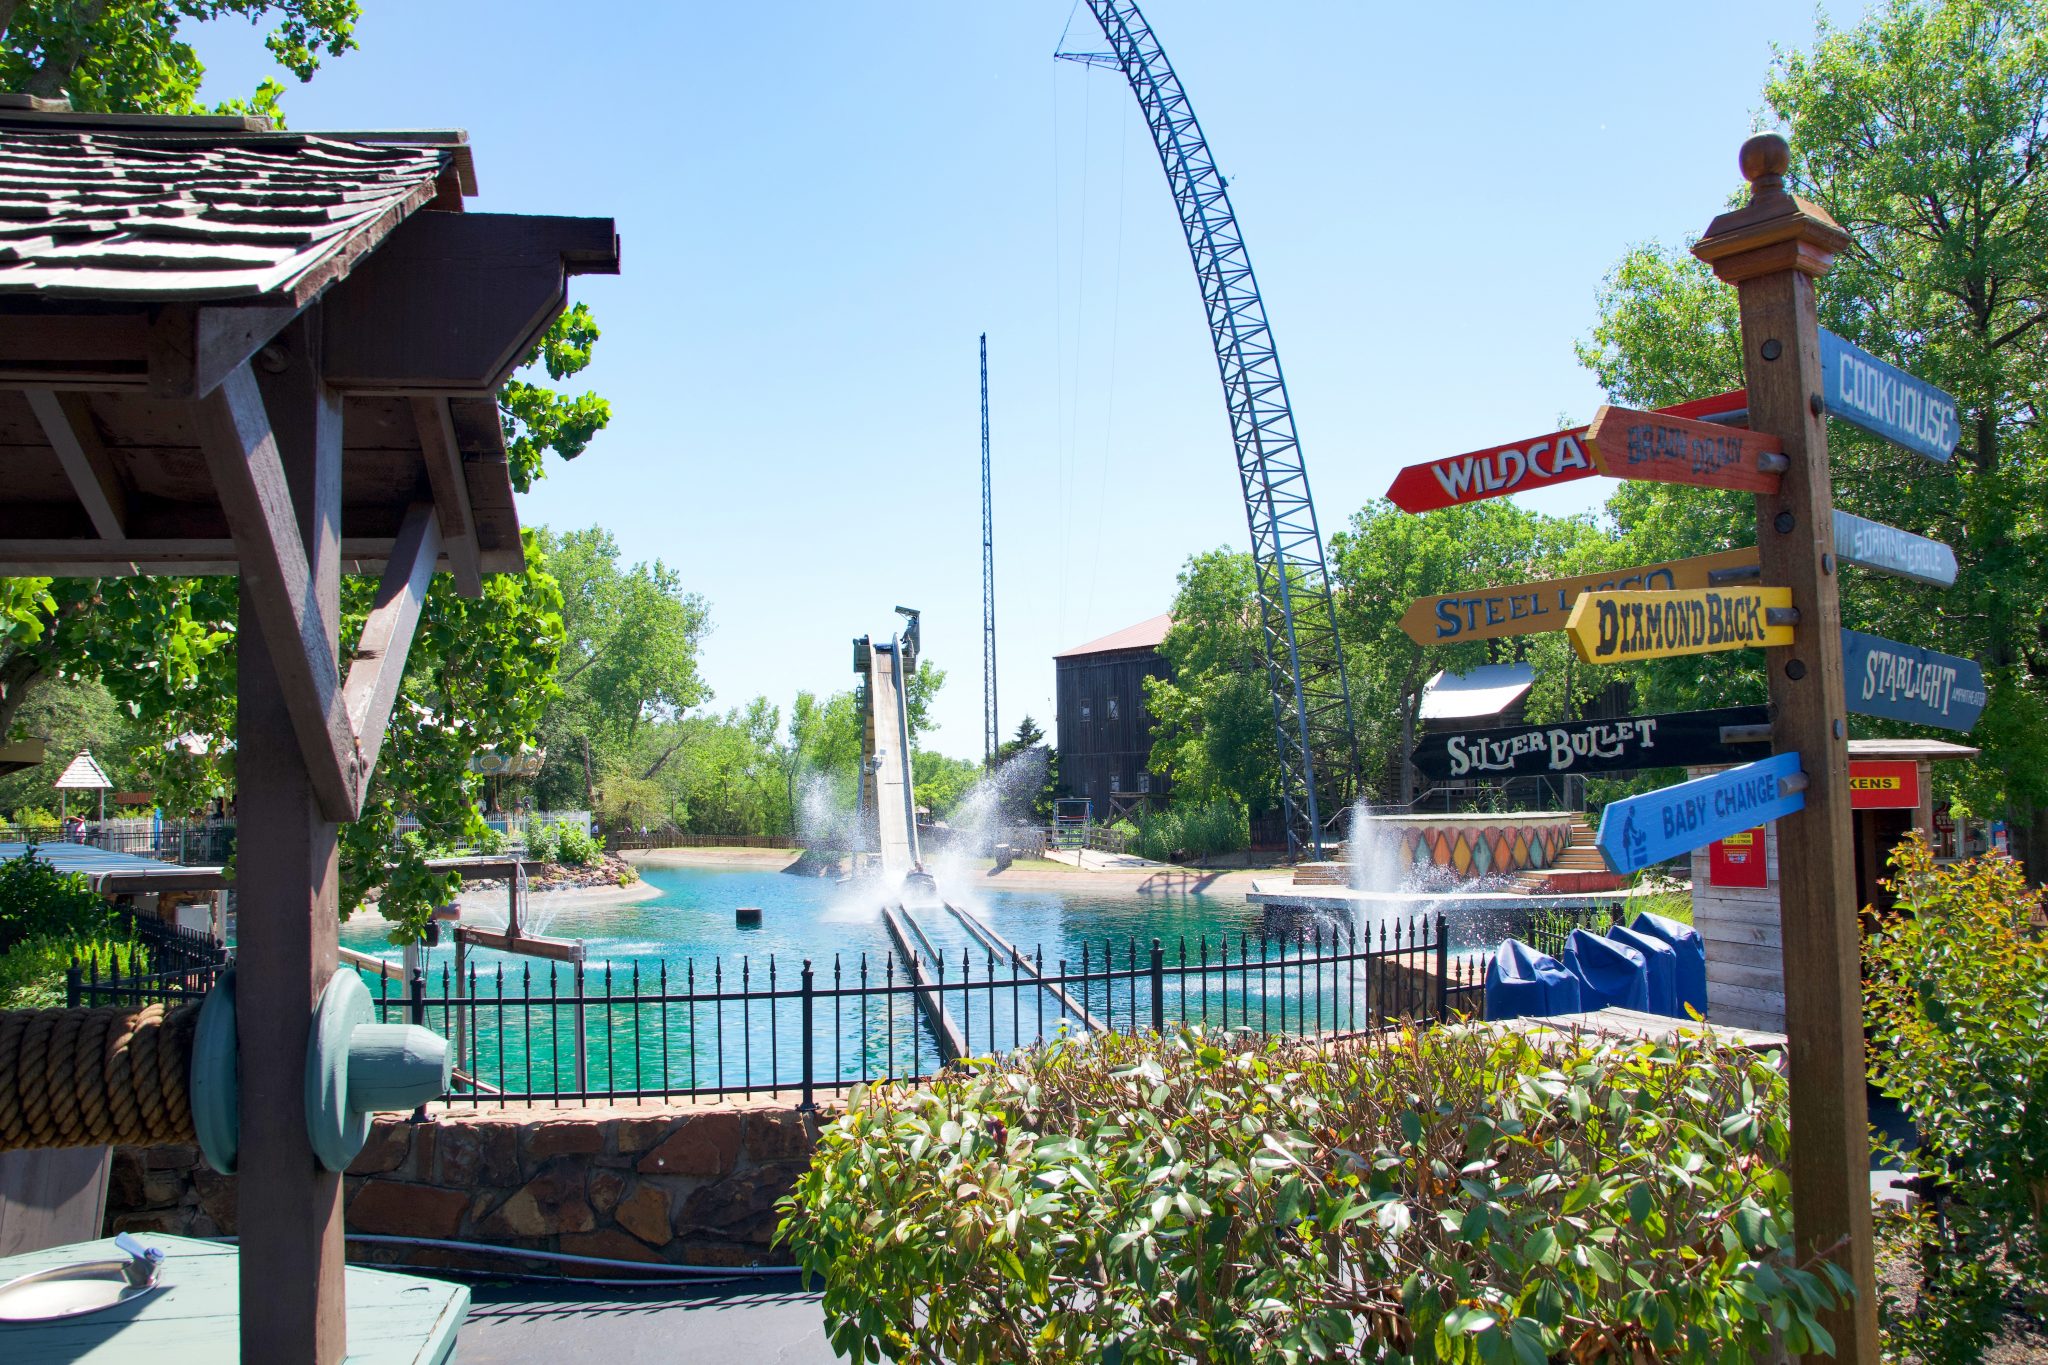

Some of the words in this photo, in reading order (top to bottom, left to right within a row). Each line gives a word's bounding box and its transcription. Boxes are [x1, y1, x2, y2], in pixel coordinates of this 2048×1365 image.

[1840, 352, 1954, 451] COOKHOUSE
[1431, 432, 1596, 499] WILDCA
[1628, 424, 1688, 464] BRAIN
[1692, 437, 1742, 474] DRAIN
[1435, 593, 1548, 638] STEEL
[1862, 650, 1956, 716] STARLIGHT
[1448, 732, 1547, 777] SILVER
[1549, 719, 1656, 770] BULLET
[1662, 795, 1706, 840] BABY
[1714, 774, 1775, 817] CHANGE
